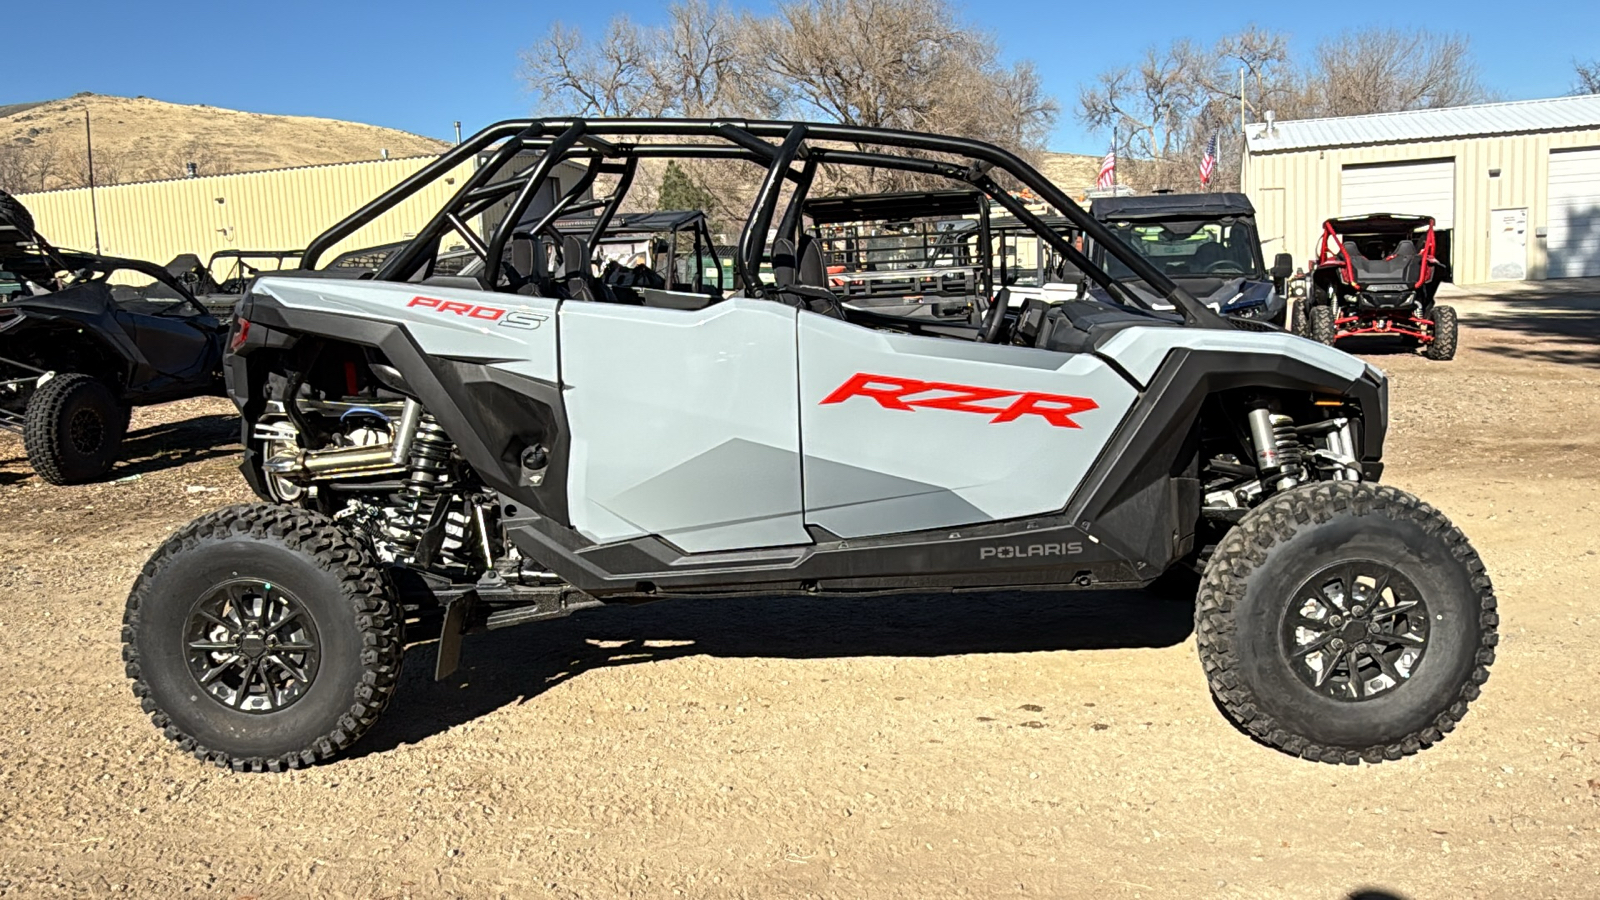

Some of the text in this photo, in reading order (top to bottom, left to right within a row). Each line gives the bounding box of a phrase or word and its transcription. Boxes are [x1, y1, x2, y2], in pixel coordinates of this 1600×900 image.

[407, 296, 506, 321] PRO
[818, 373, 1100, 429] RZR
[980, 542, 1083, 560] POLARIS
